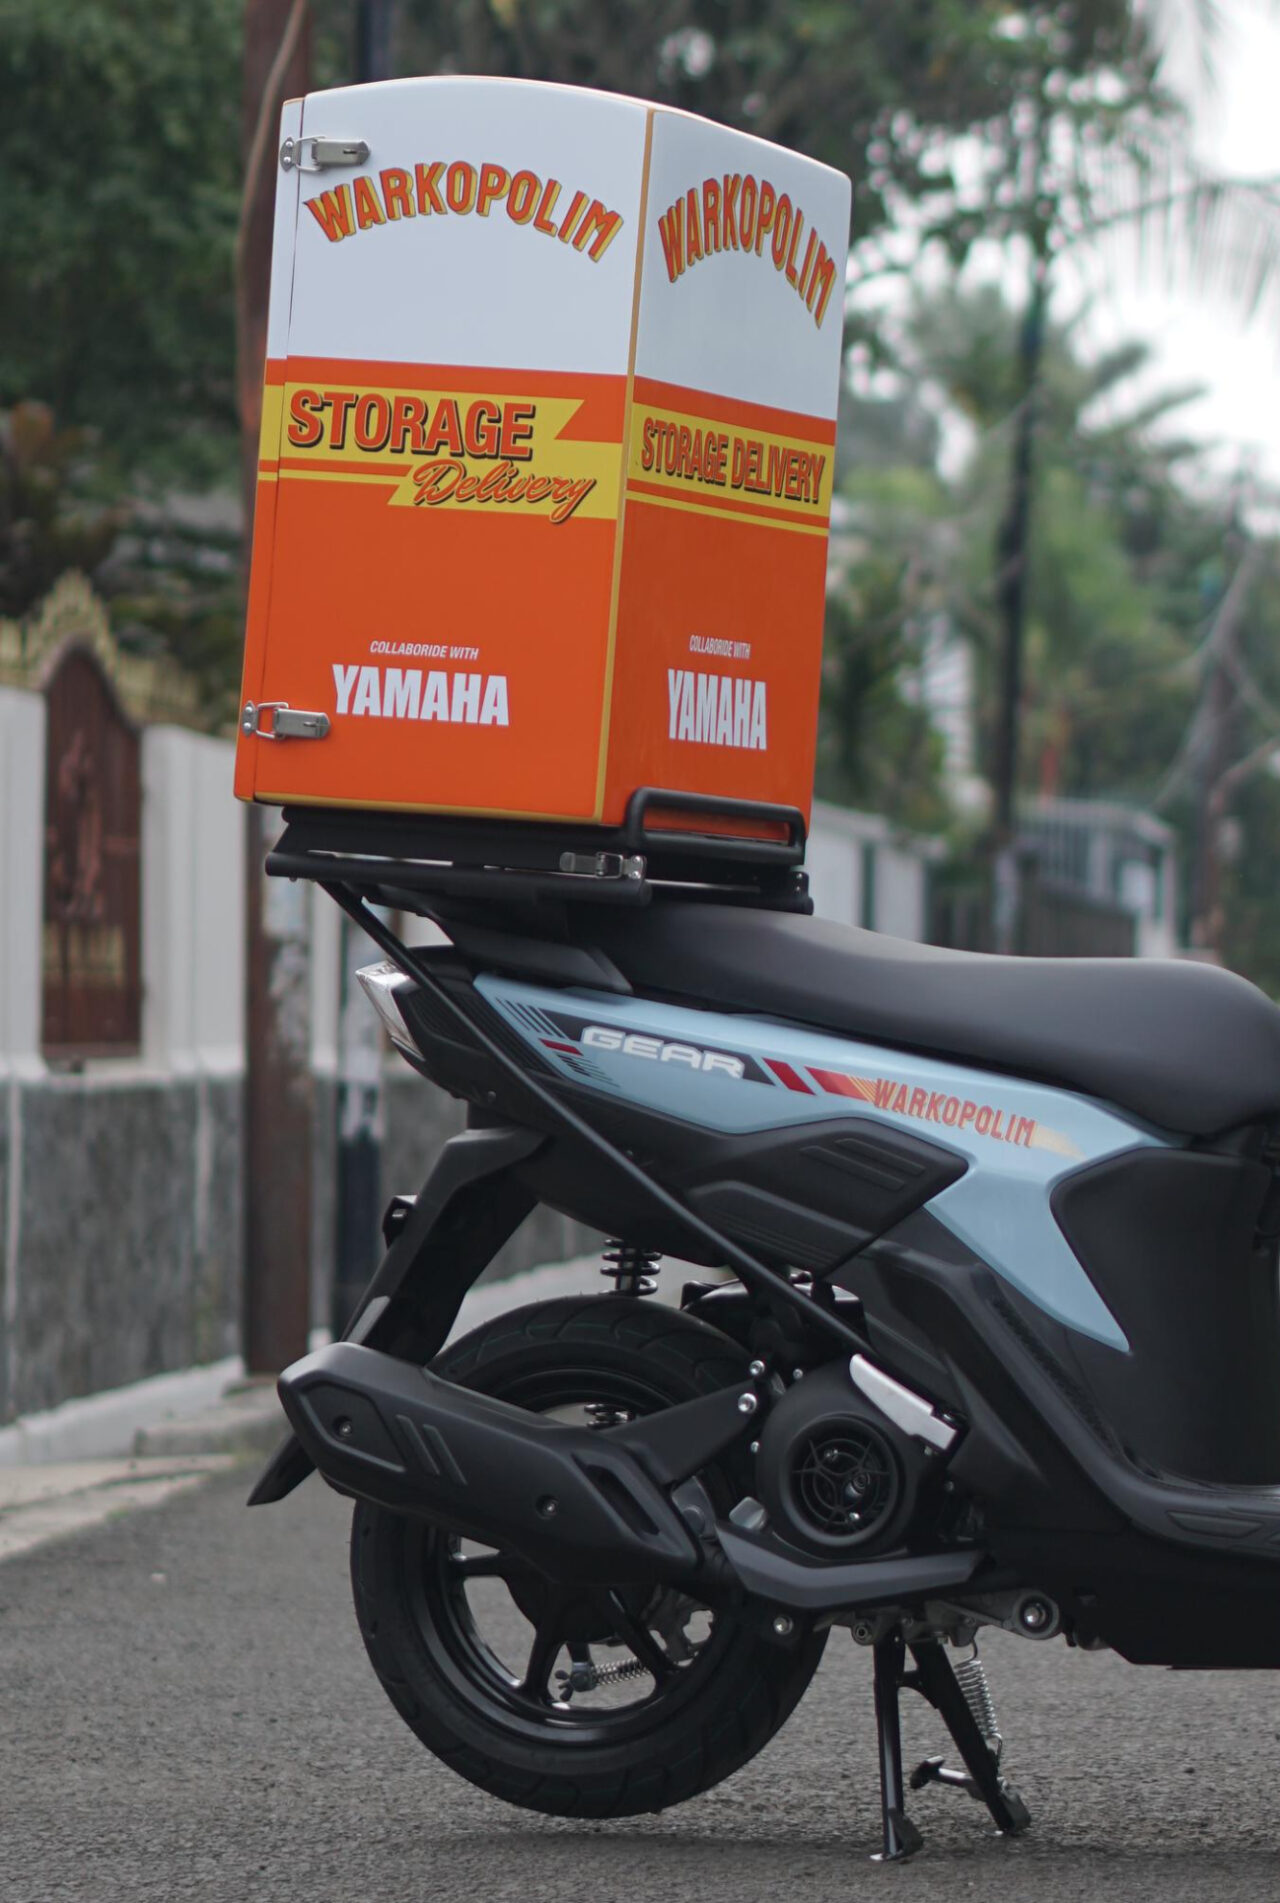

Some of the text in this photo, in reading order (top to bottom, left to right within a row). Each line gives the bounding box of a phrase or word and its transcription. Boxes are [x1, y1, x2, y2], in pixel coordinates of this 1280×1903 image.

[304, 161, 625, 263] WARKOPOLIM
[658, 174, 836, 328] WARKOPOLIM
[286, 388, 537, 458] STORAGE
[411, 457, 596, 524] Delivery
[641, 416, 826, 504] STORAGE DELIVERY
[369, 640, 480, 660] COLLABORIDE WITH
[689, 634, 751, 660] COLLABORIDE WITH
[333, 664, 509, 726] YAMAHA
[668, 669, 767, 750] YAMAHA
[581, 1025, 745, 1079] GEAR
[874, 1078, 1036, 1148] WARKOPOLIM
